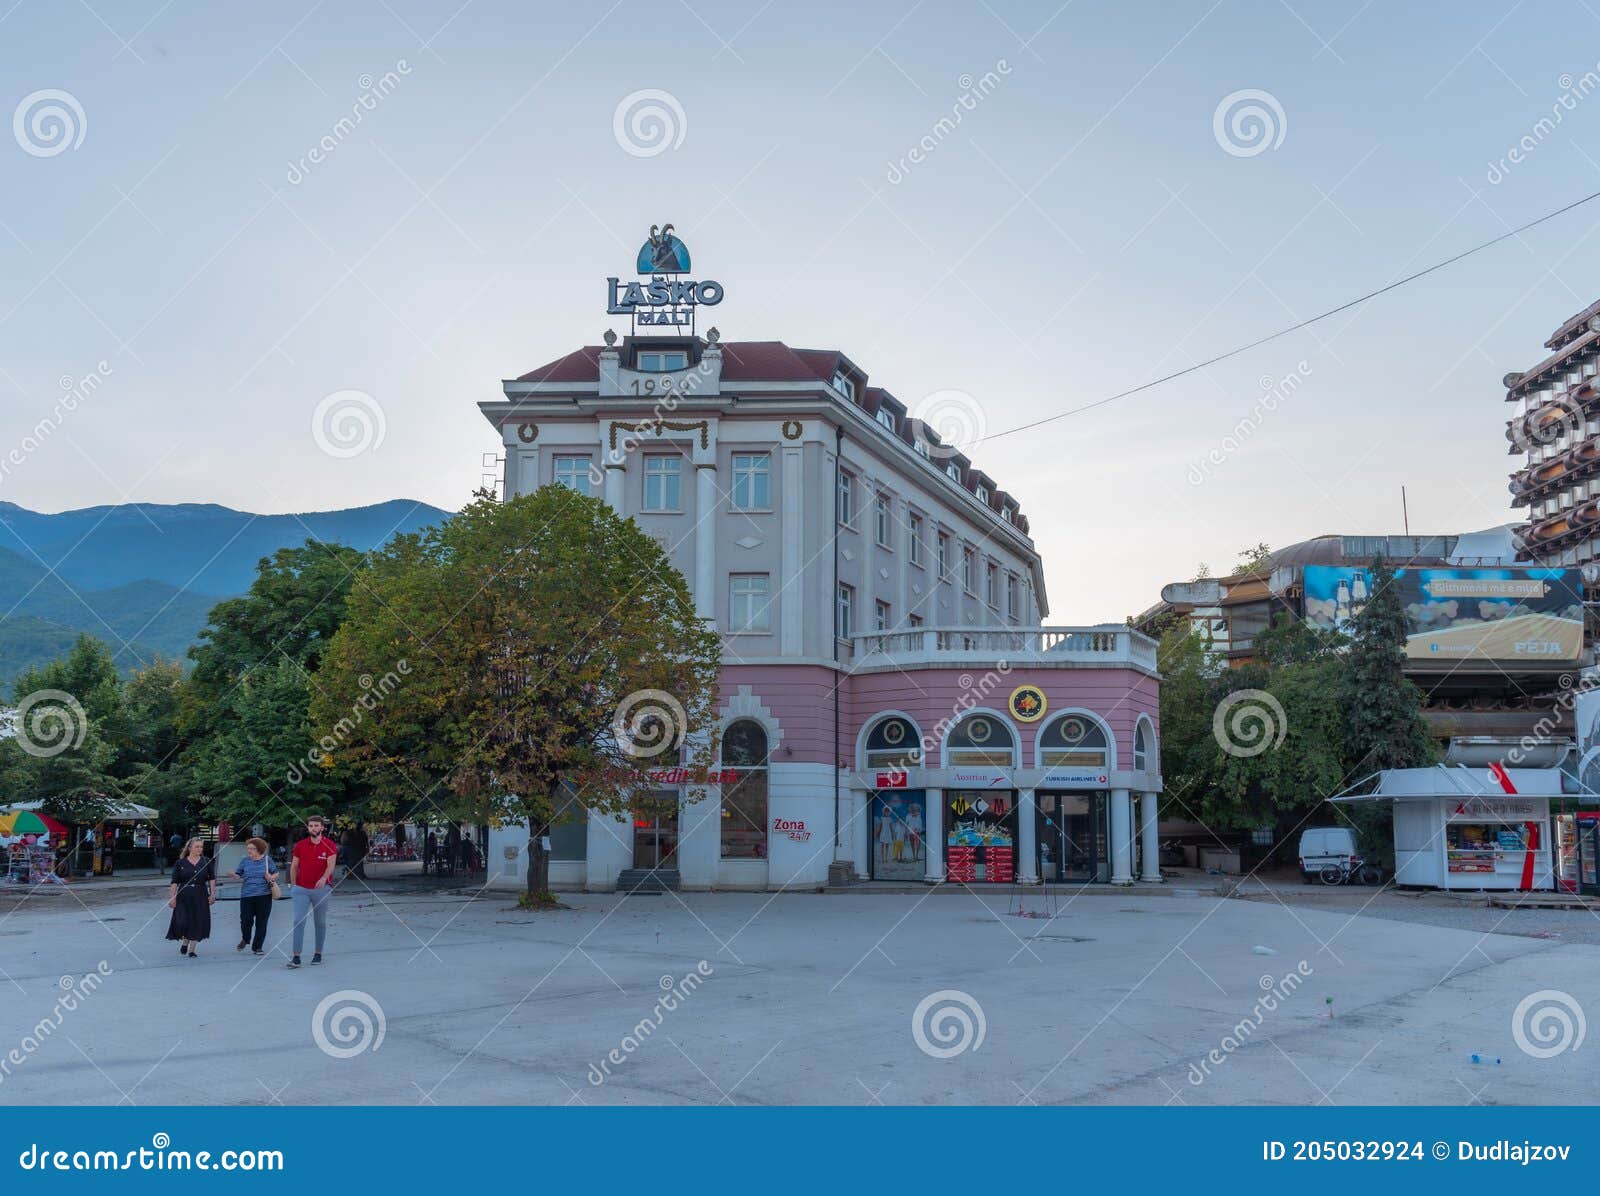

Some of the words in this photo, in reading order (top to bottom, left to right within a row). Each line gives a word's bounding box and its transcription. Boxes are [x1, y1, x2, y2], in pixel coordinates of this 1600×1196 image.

[607, 277, 724, 314] LAŠKO
[638, 309, 694, 325] MALT
[954, 773, 988, 782] Austrian
[1045, 775, 1070, 783] TURKISH
[1071, 775, 1096, 783] AIRLINES
[774, 818, 805, 830] Zona
